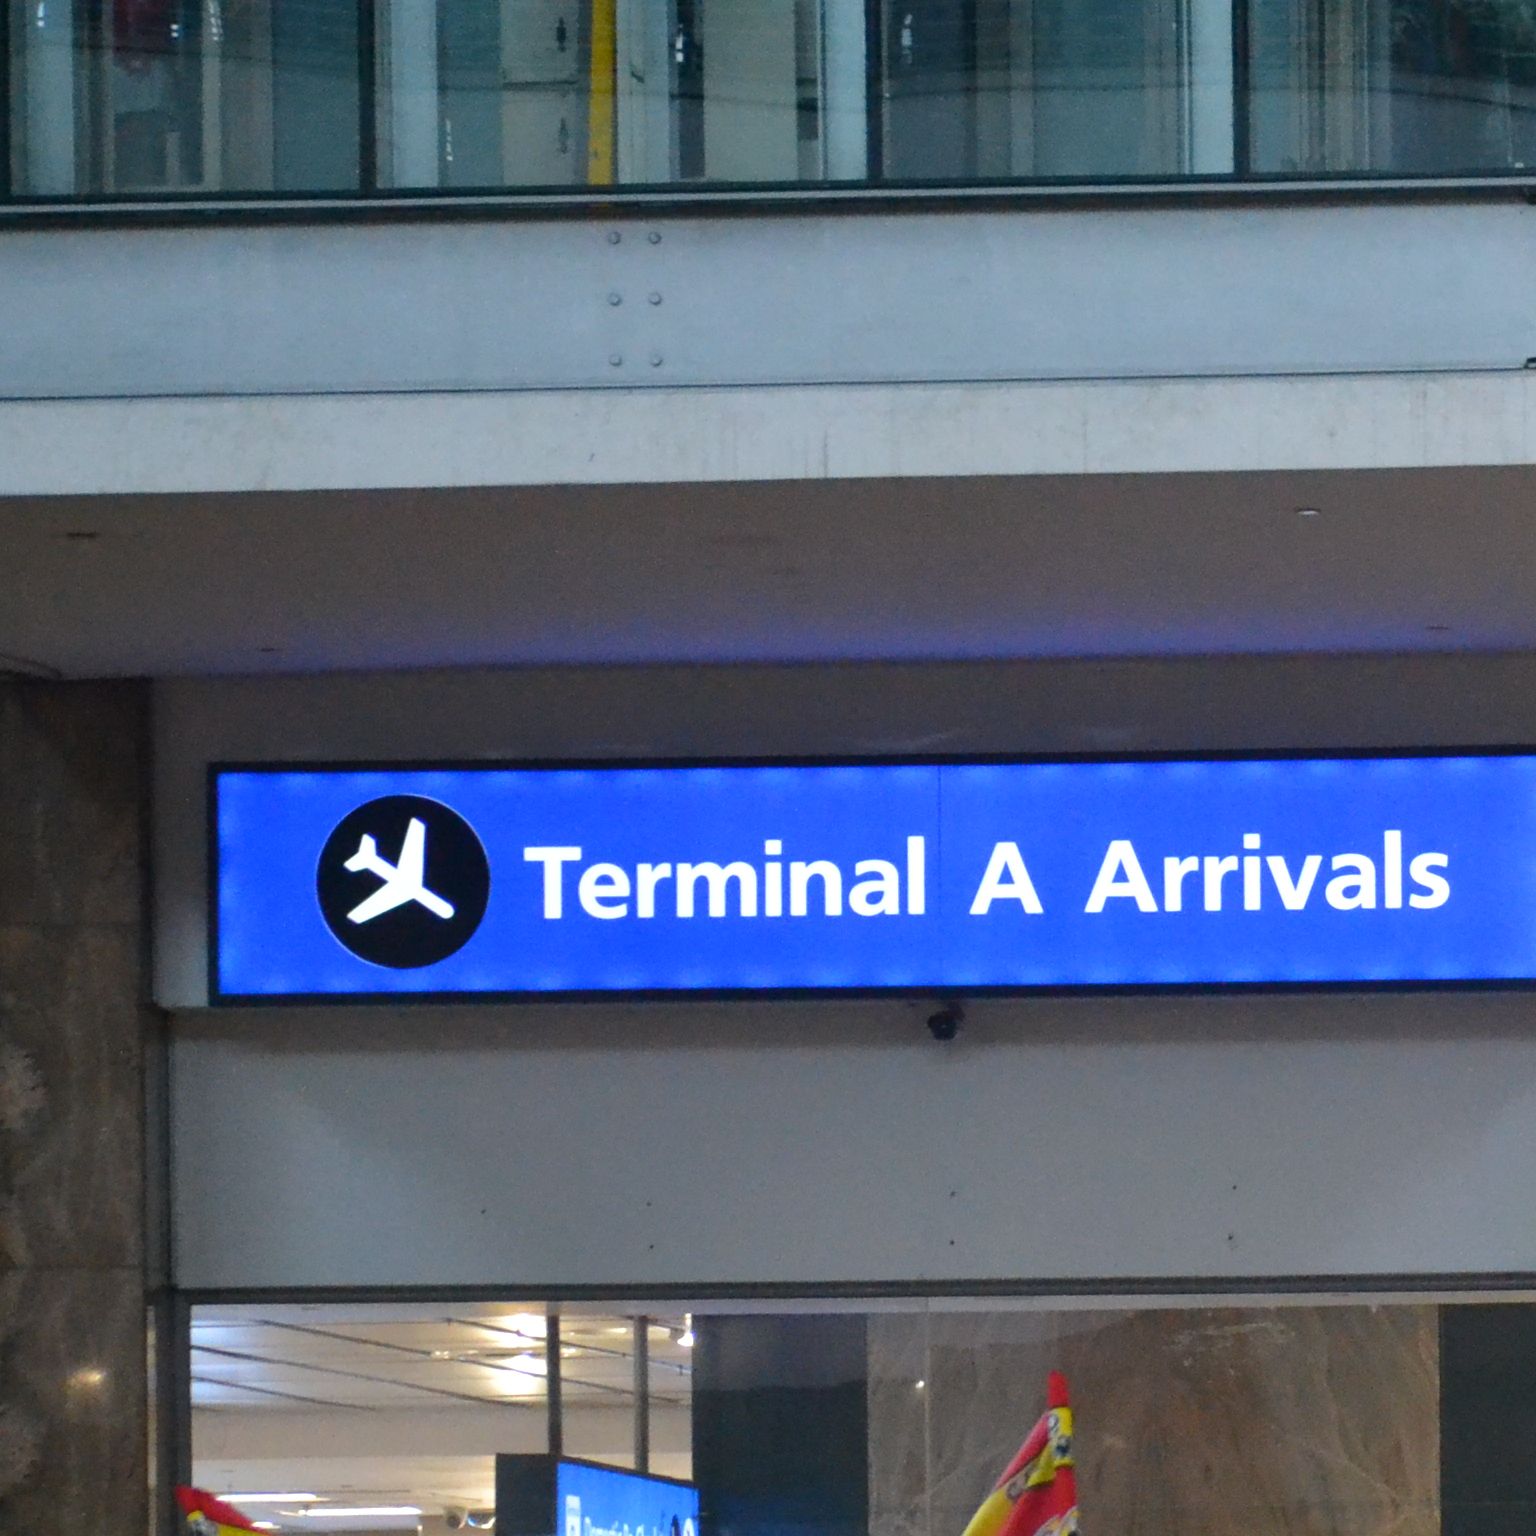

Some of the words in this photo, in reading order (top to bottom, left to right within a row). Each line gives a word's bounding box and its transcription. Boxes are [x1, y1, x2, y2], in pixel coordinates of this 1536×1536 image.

[523, 834, 925, 920] Terminal
[970, 842, 1044, 916] A
[1084, 830, 1452, 913] Arrivals
